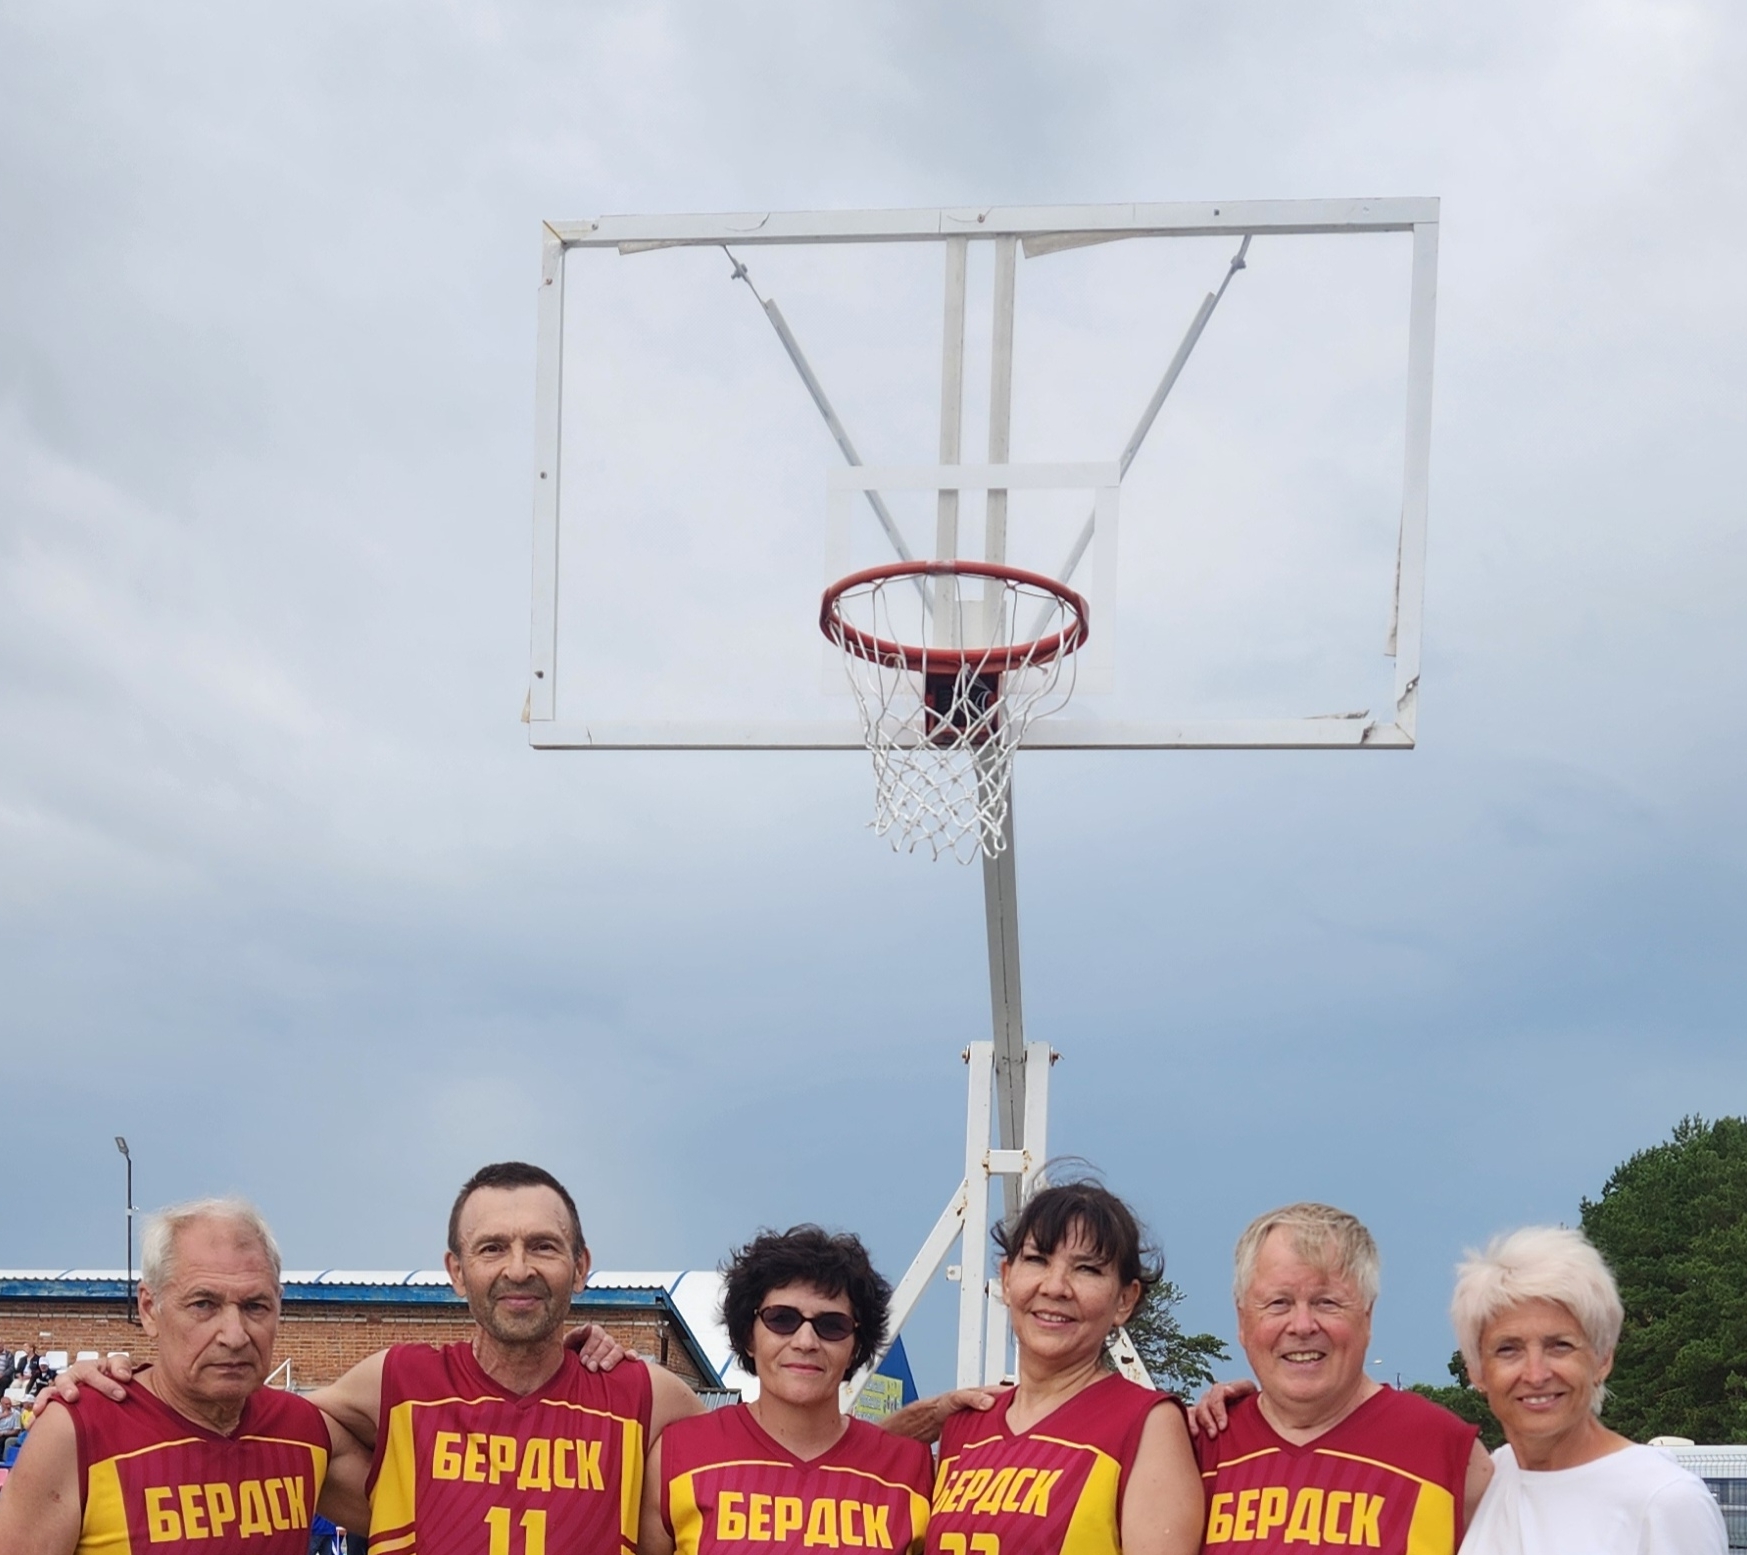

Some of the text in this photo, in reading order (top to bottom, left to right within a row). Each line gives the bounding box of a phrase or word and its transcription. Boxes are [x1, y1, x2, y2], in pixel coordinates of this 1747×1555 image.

[432, 1432, 604, 1491] БЕРДСК
[144, 1475, 308, 1543] БЕРДСК
[717, 1491, 893, 1550] БЕРДСК
[1206, 1487, 1385, 1548] БЕРДСК
